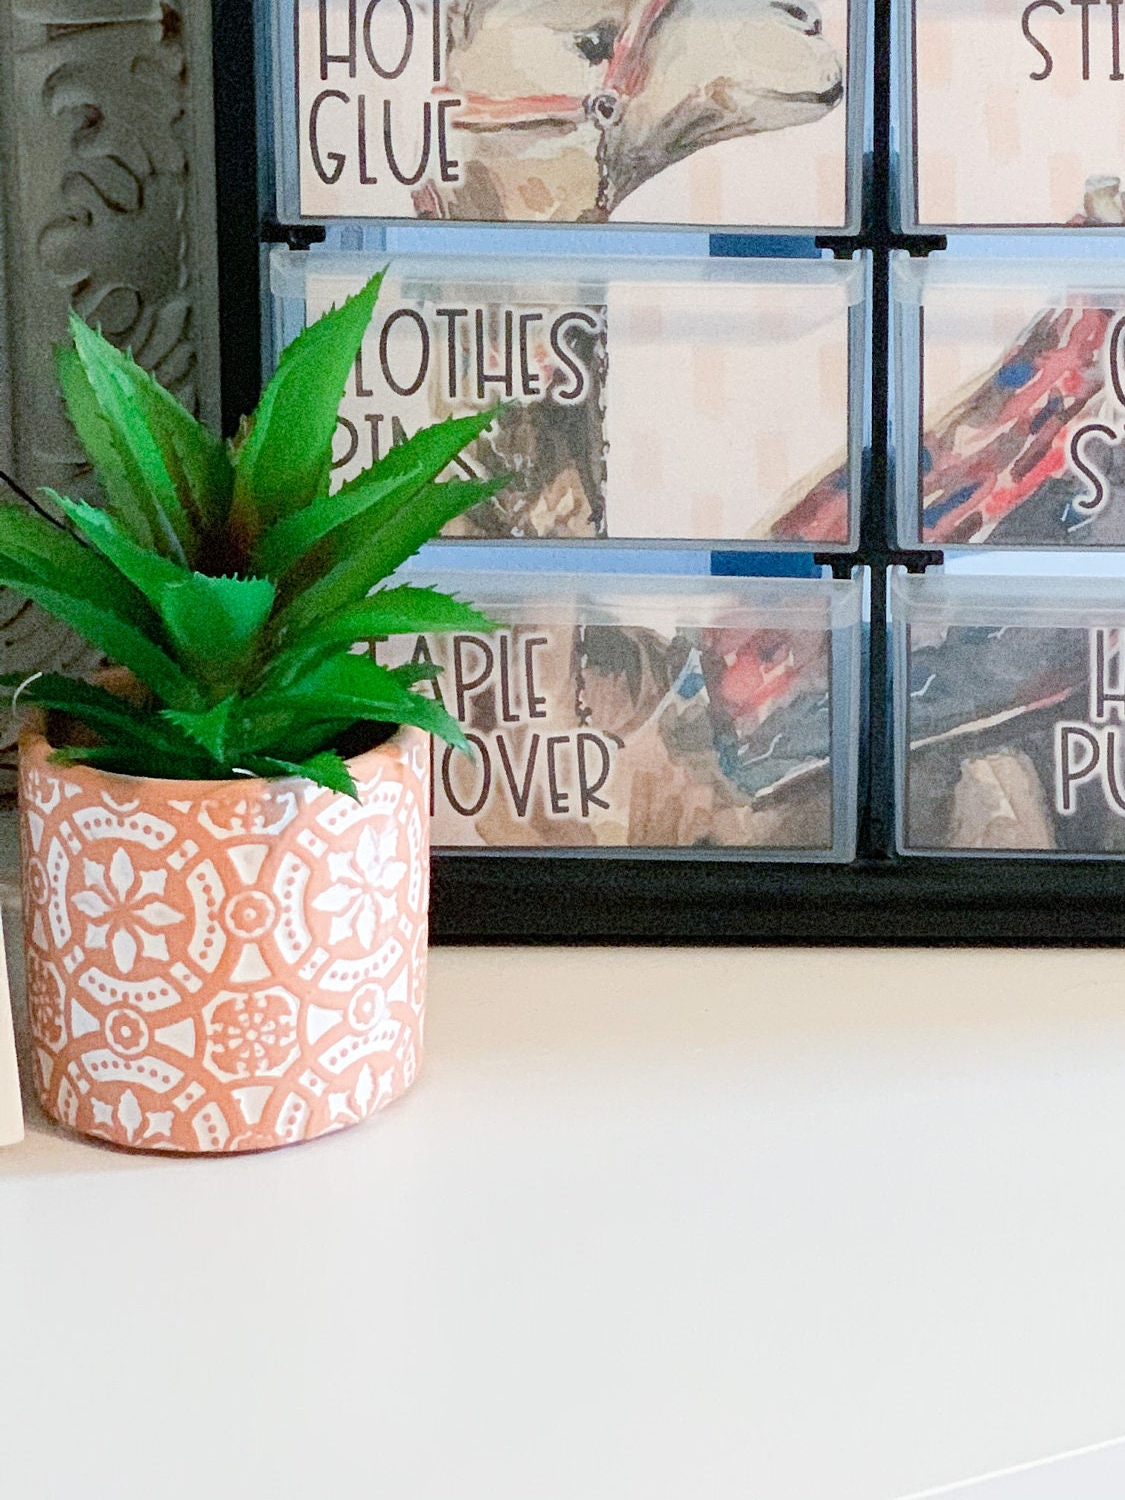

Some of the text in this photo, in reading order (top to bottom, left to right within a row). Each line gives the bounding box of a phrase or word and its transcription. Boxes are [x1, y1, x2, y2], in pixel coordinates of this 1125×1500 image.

[308, 89, 462, 186] GLUE
[341, 308, 598, 399] LOTHES
[429, 732, 625, 817] OVER
